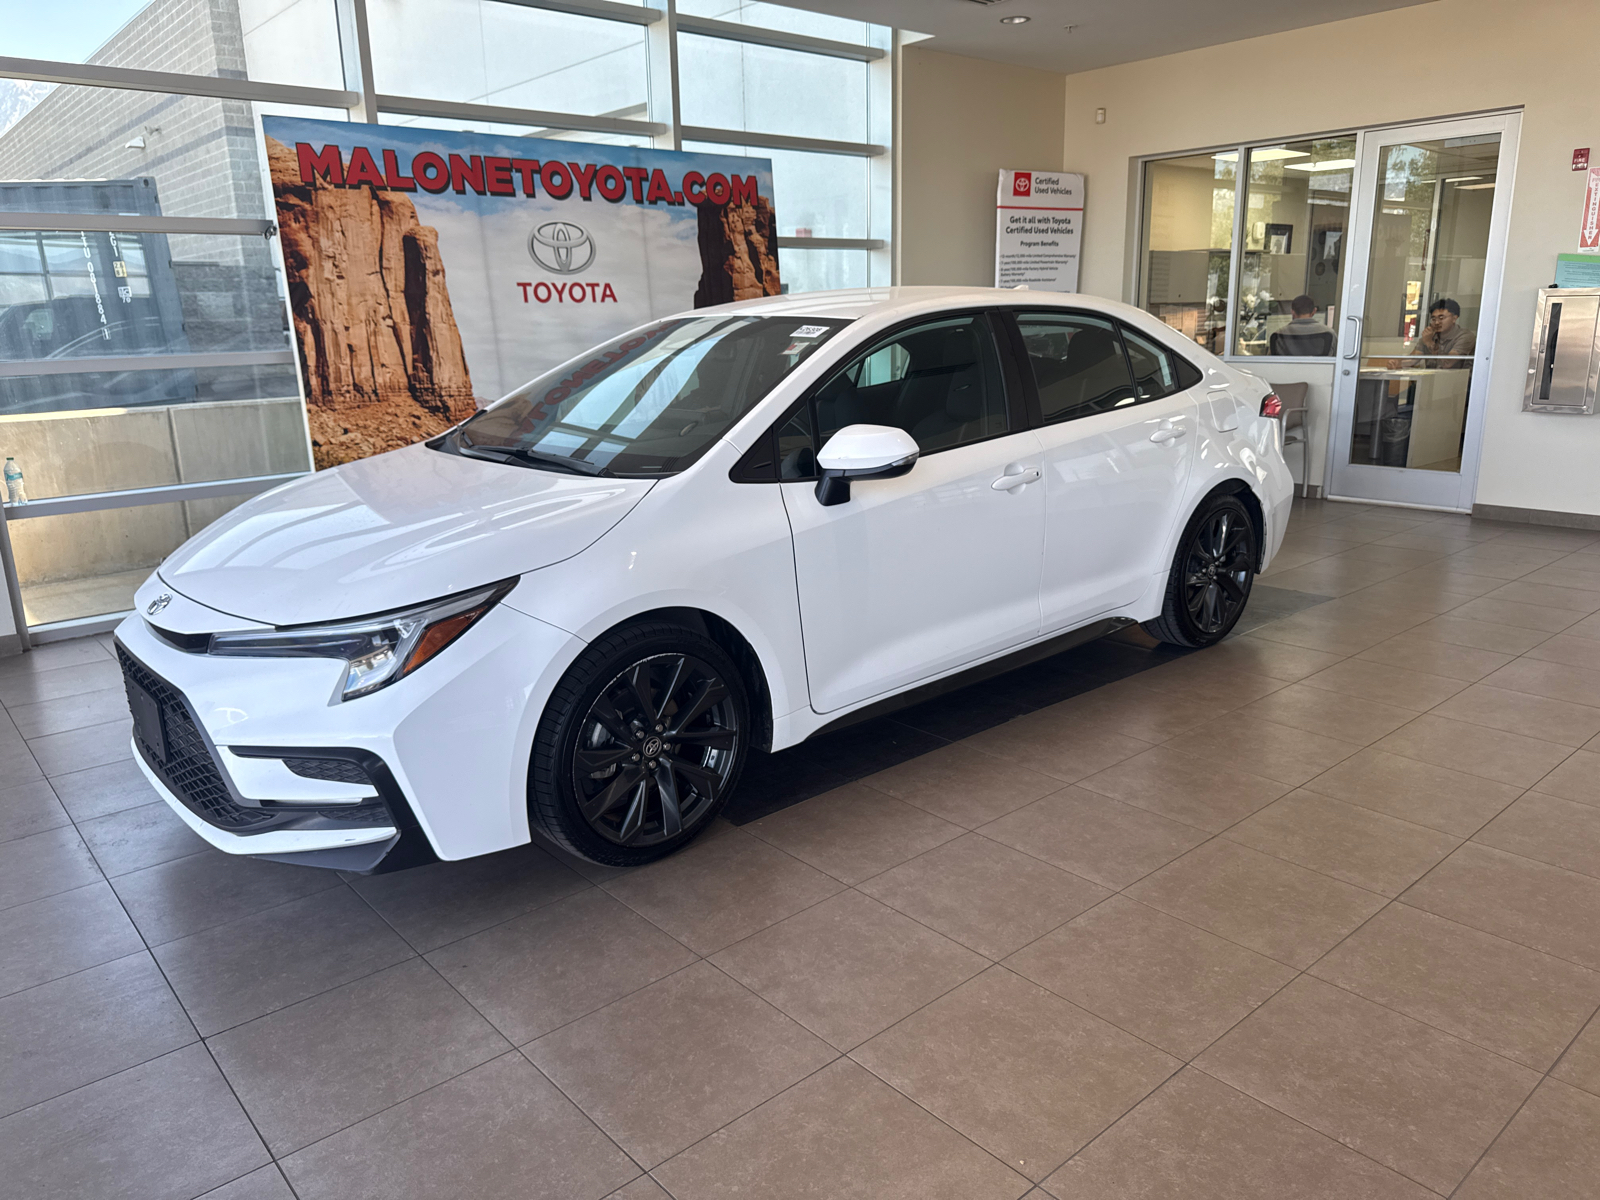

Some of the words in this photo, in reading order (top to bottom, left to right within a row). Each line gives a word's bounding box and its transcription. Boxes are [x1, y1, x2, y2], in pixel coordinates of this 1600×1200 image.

[295, 142, 759, 208] MALONETOYOTA.COM
[1035, 177, 1059, 185] Certified
[1050, 187, 1072, 195] Vehicles
[1588, 183, 1599, 240] EXTINGUISHER
[1010, 216, 1021, 224] Get
[1022, 216, 1027, 224] it
[1028, 216, 1036, 224] all
[1037, 216, 1050, 225] with
[1051, 217, 1071, 226] Toyota
[1006, 226, 1032, 234] Certified
[1050, 227, 1073, 235] Vehicles
[517, 282, 618, 303] TOYOTA
